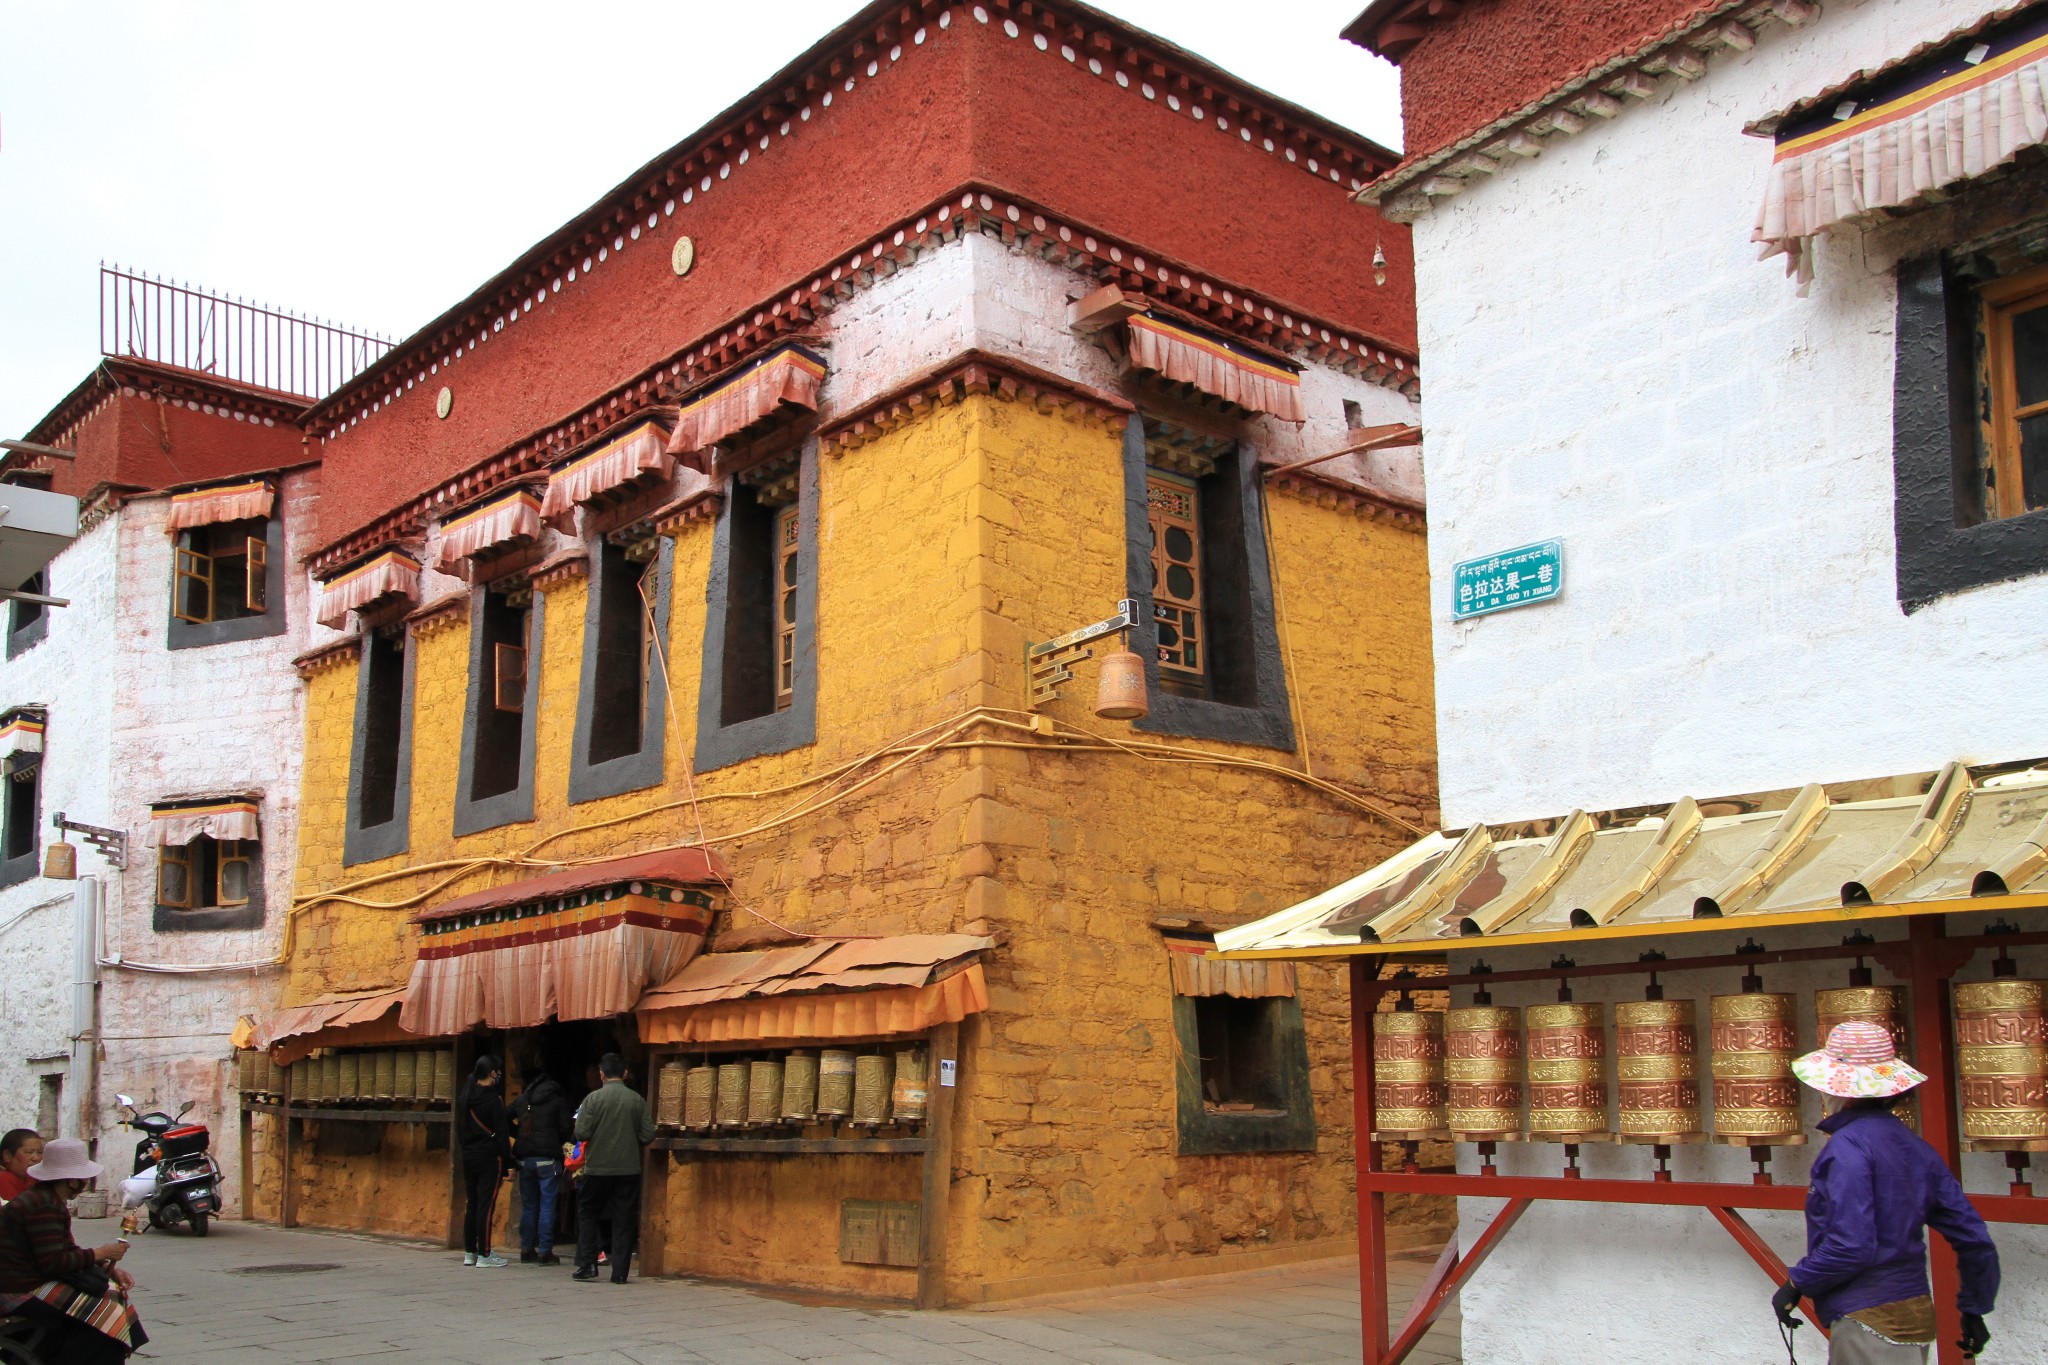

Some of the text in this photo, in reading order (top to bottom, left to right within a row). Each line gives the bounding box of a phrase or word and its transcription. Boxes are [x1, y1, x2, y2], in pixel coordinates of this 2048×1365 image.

[1460, 564, 1553, 602] 色拉达果一巷
[1462, 584, 1552, 612] SE LA DA GUO YI XIANG
